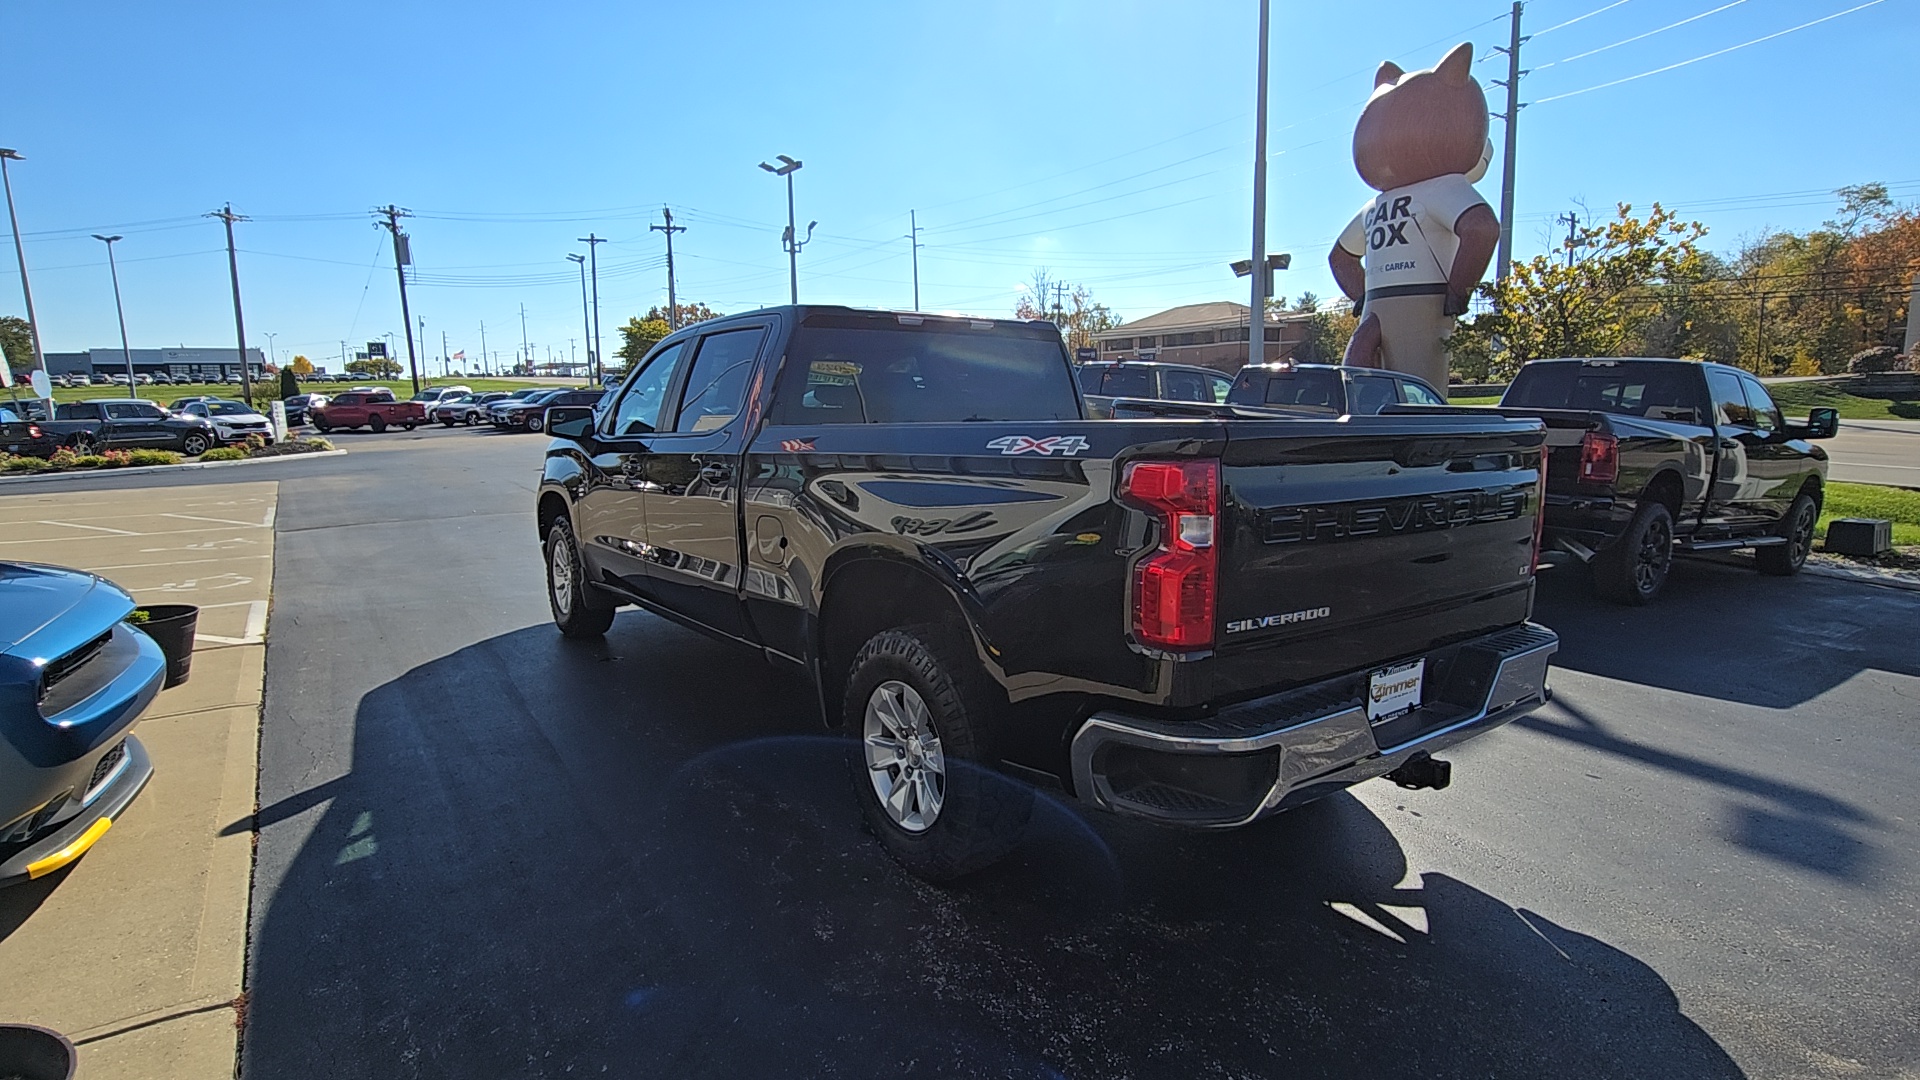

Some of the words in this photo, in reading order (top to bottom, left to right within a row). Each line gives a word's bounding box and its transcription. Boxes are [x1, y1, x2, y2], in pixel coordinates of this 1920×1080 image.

[1365, 196, 1412, 229] CAR
[1385, 261, 1416, 272] CARFAX
[1226, 606, 1331, 634] SILVERADO
[1373, 677, 1417, 699] Zimmer
